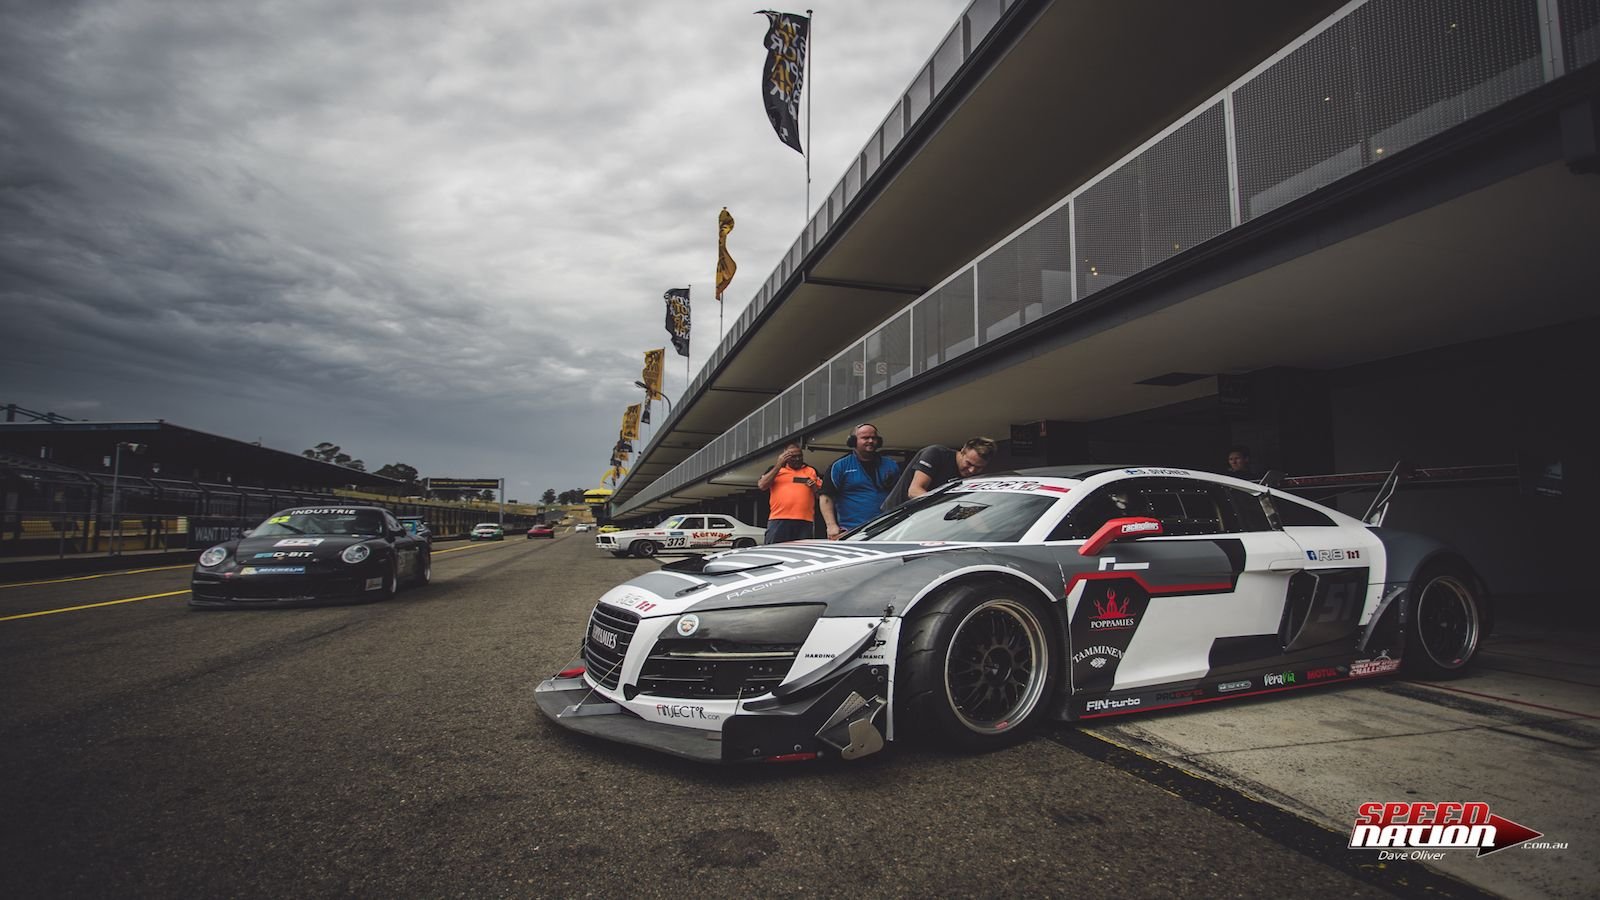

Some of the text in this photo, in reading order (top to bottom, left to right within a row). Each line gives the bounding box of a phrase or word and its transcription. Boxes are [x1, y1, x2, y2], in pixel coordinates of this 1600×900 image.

[195, 527, 217, 541] WANT
[667, 537, 685, 547] 373
[1319, 549, 1344, 561] R8
[1090, 618, 1135, 628] POPPAMIES
[1306, 668, 1337, 680] MOTUL
